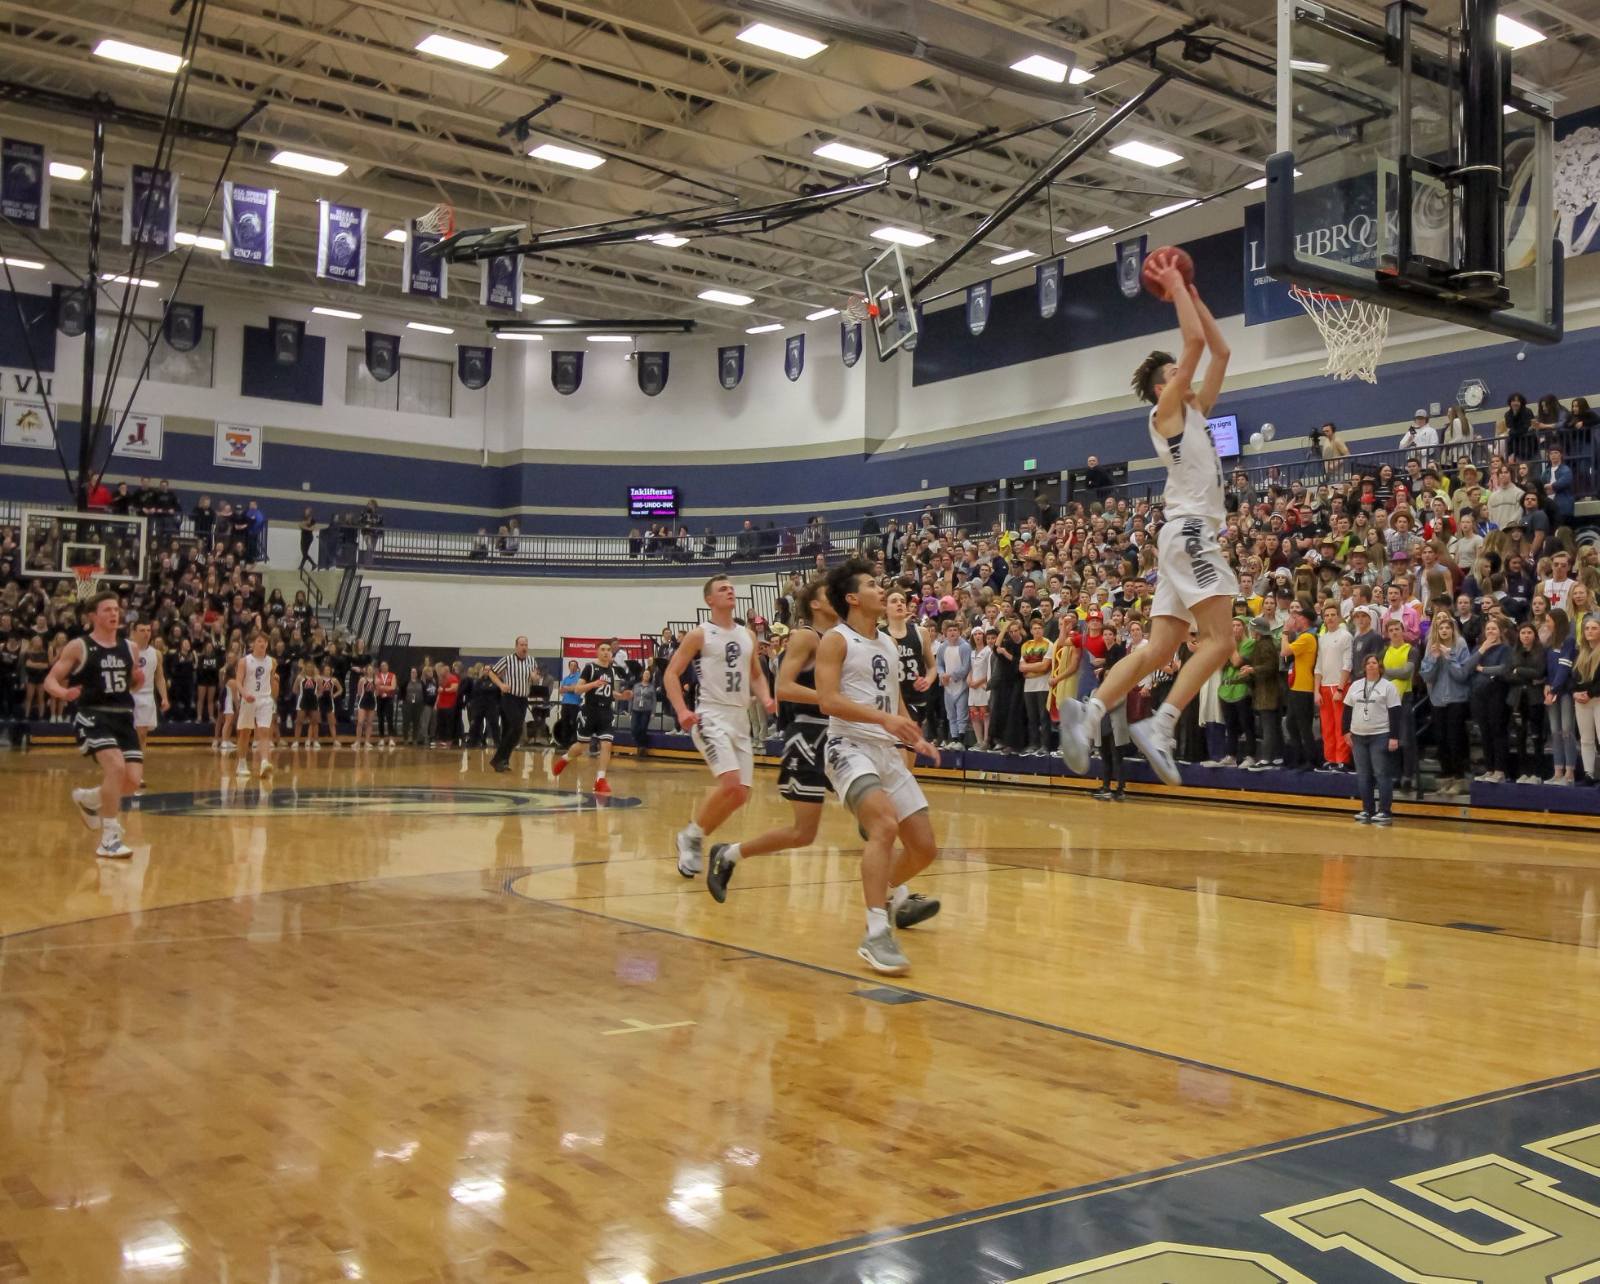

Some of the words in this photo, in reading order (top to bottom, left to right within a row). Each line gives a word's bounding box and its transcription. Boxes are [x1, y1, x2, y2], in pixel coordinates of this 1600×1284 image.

[1217, 421, 1232, 429] signs
[631, 488, 667, 496] Inklifters
[101, 654, 126, 668] alta
[101, 671, 127, 693] 15
[254, 681, 261, 692] 3
[725, 671, 741, 692] 32
[595, 684, 611, 697] 20
